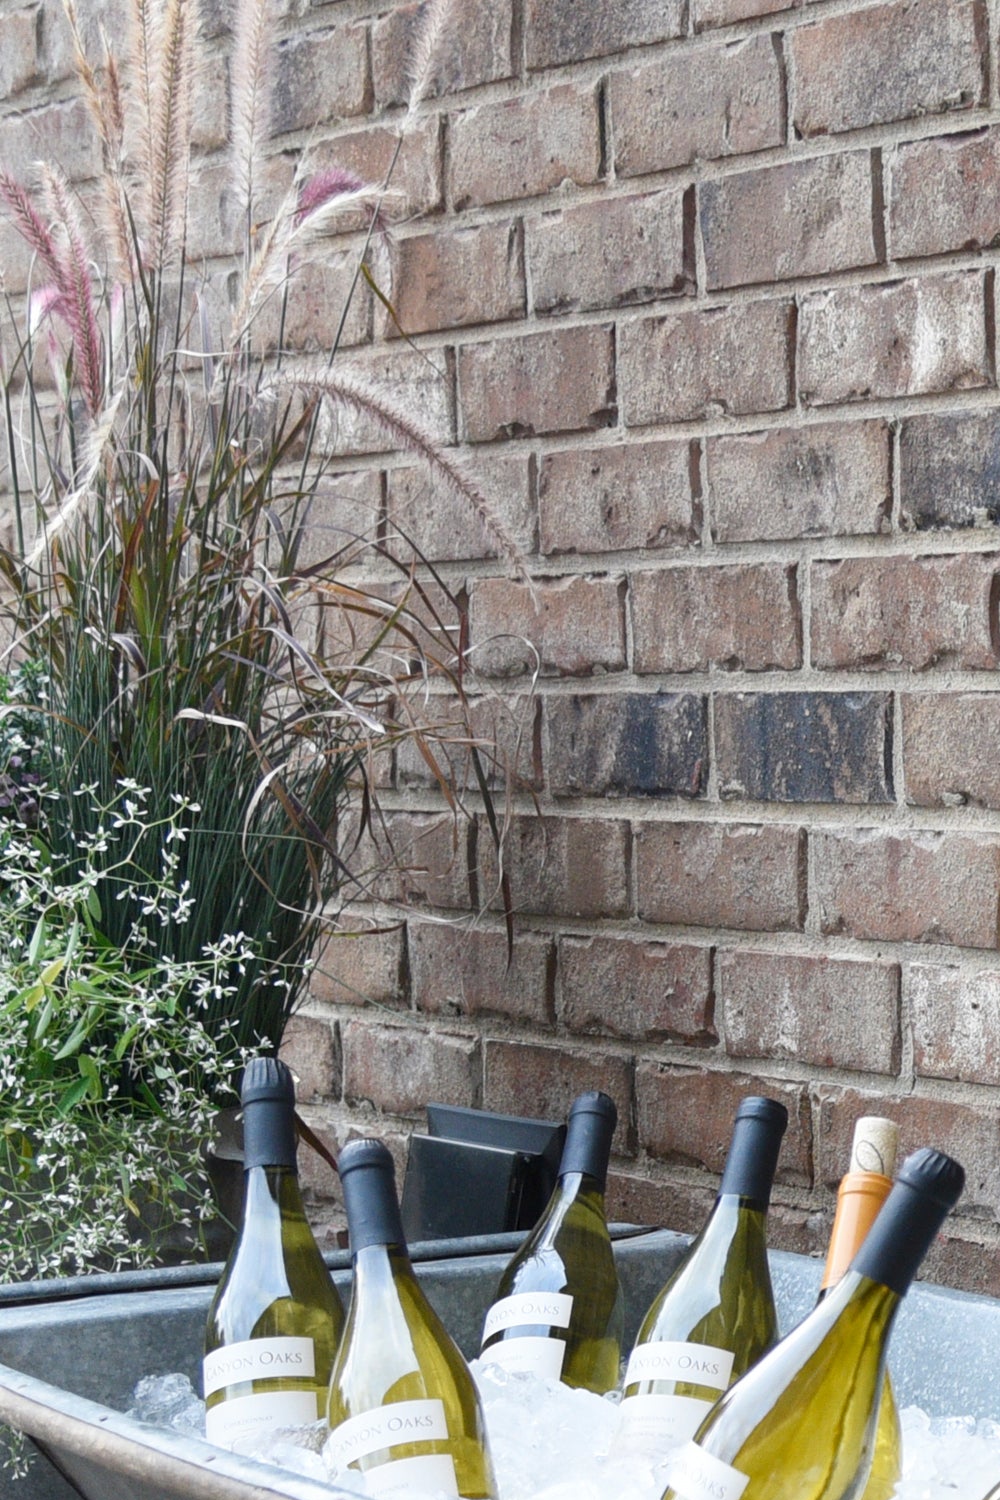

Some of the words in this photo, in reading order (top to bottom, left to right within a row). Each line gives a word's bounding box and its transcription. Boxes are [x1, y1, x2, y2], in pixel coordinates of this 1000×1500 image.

[521, 1303, 560, 1316] OAKS
[206, 1357, 254, 1381] CANYON
[259, 1351, 303, 1365] OAKS
[678, 1355, 720, 1376] OAKS
[387, 1415, 434, 1432] OAKS
[691, 1468, 729, 1500] OAKS
